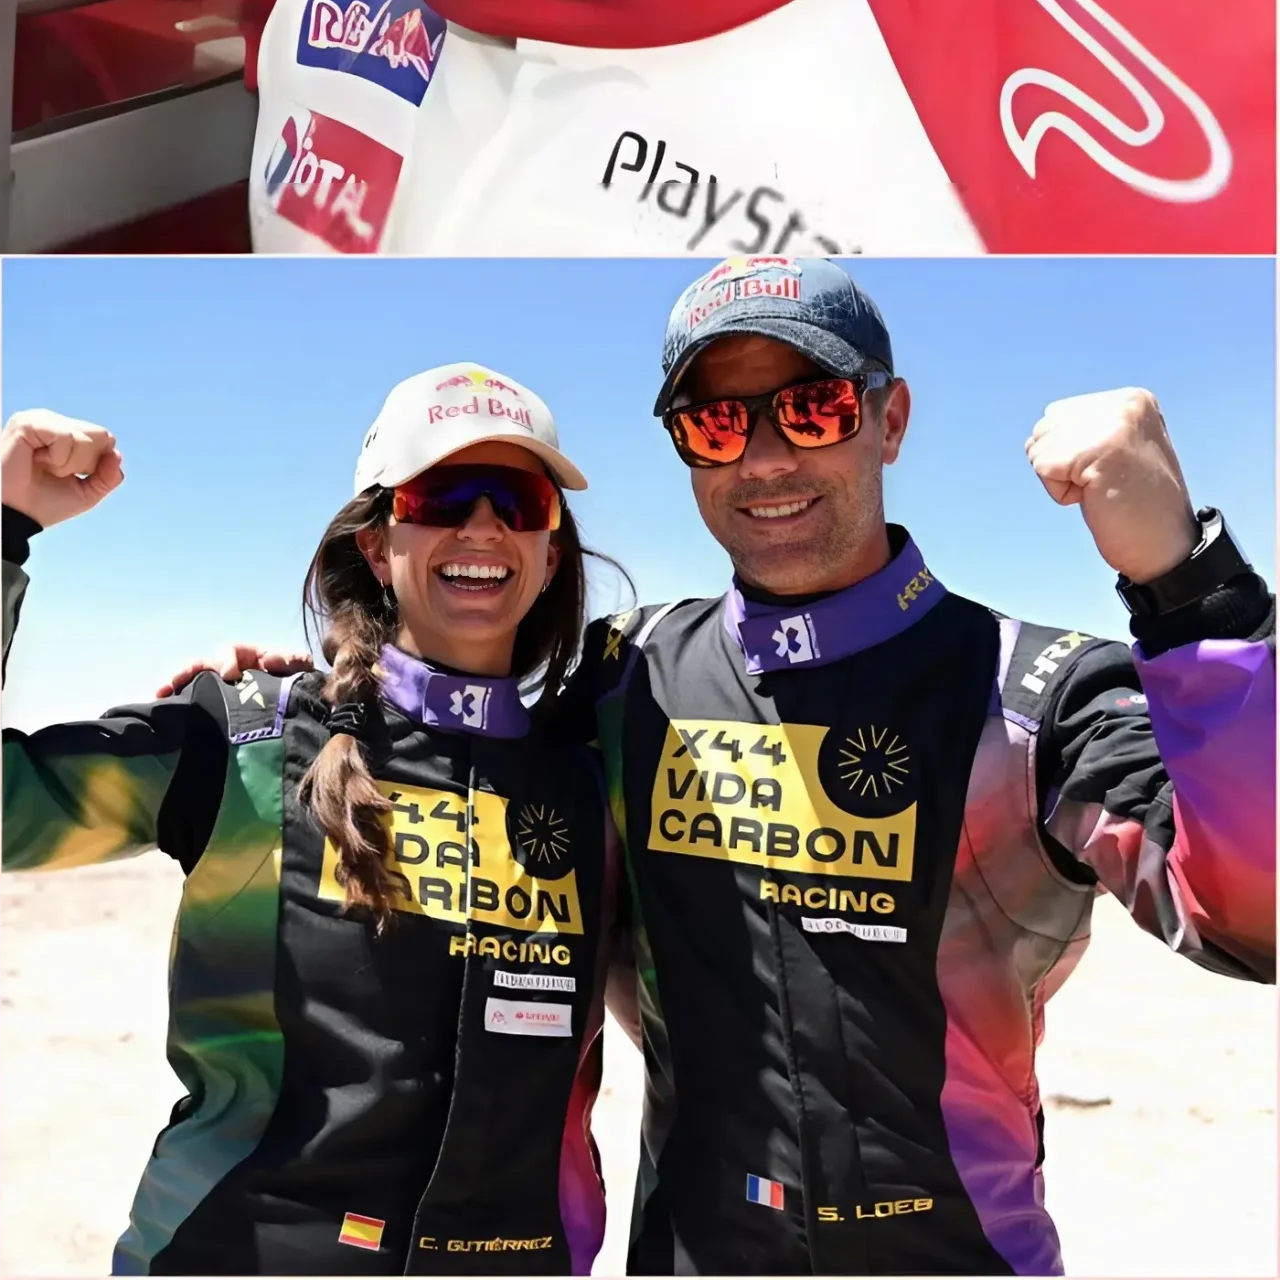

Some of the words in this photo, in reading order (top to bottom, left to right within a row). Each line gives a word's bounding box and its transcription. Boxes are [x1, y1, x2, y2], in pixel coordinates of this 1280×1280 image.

[742, 276, 801, 300] Bull
[428, 396, 479, 425] Red
[488, 398, 532, 427] Bull
[897, 568, 934, 612] HRX
[1020, 630, 1096, 695] HRX
[672, 728, 787, 767] X44
[667, 767, 783, 812] VIDA
[387, 792, 480, 833] 44
[659, 809, 900, 868] CARBON
[759, 878, 896, 915] RACING
[449, 932, 571, 966] RACING
[817, 1206, 845, 1222] S.
[855, 1198, 934, 1219] LOEB
[419, 1236, 438, 1251] C.
